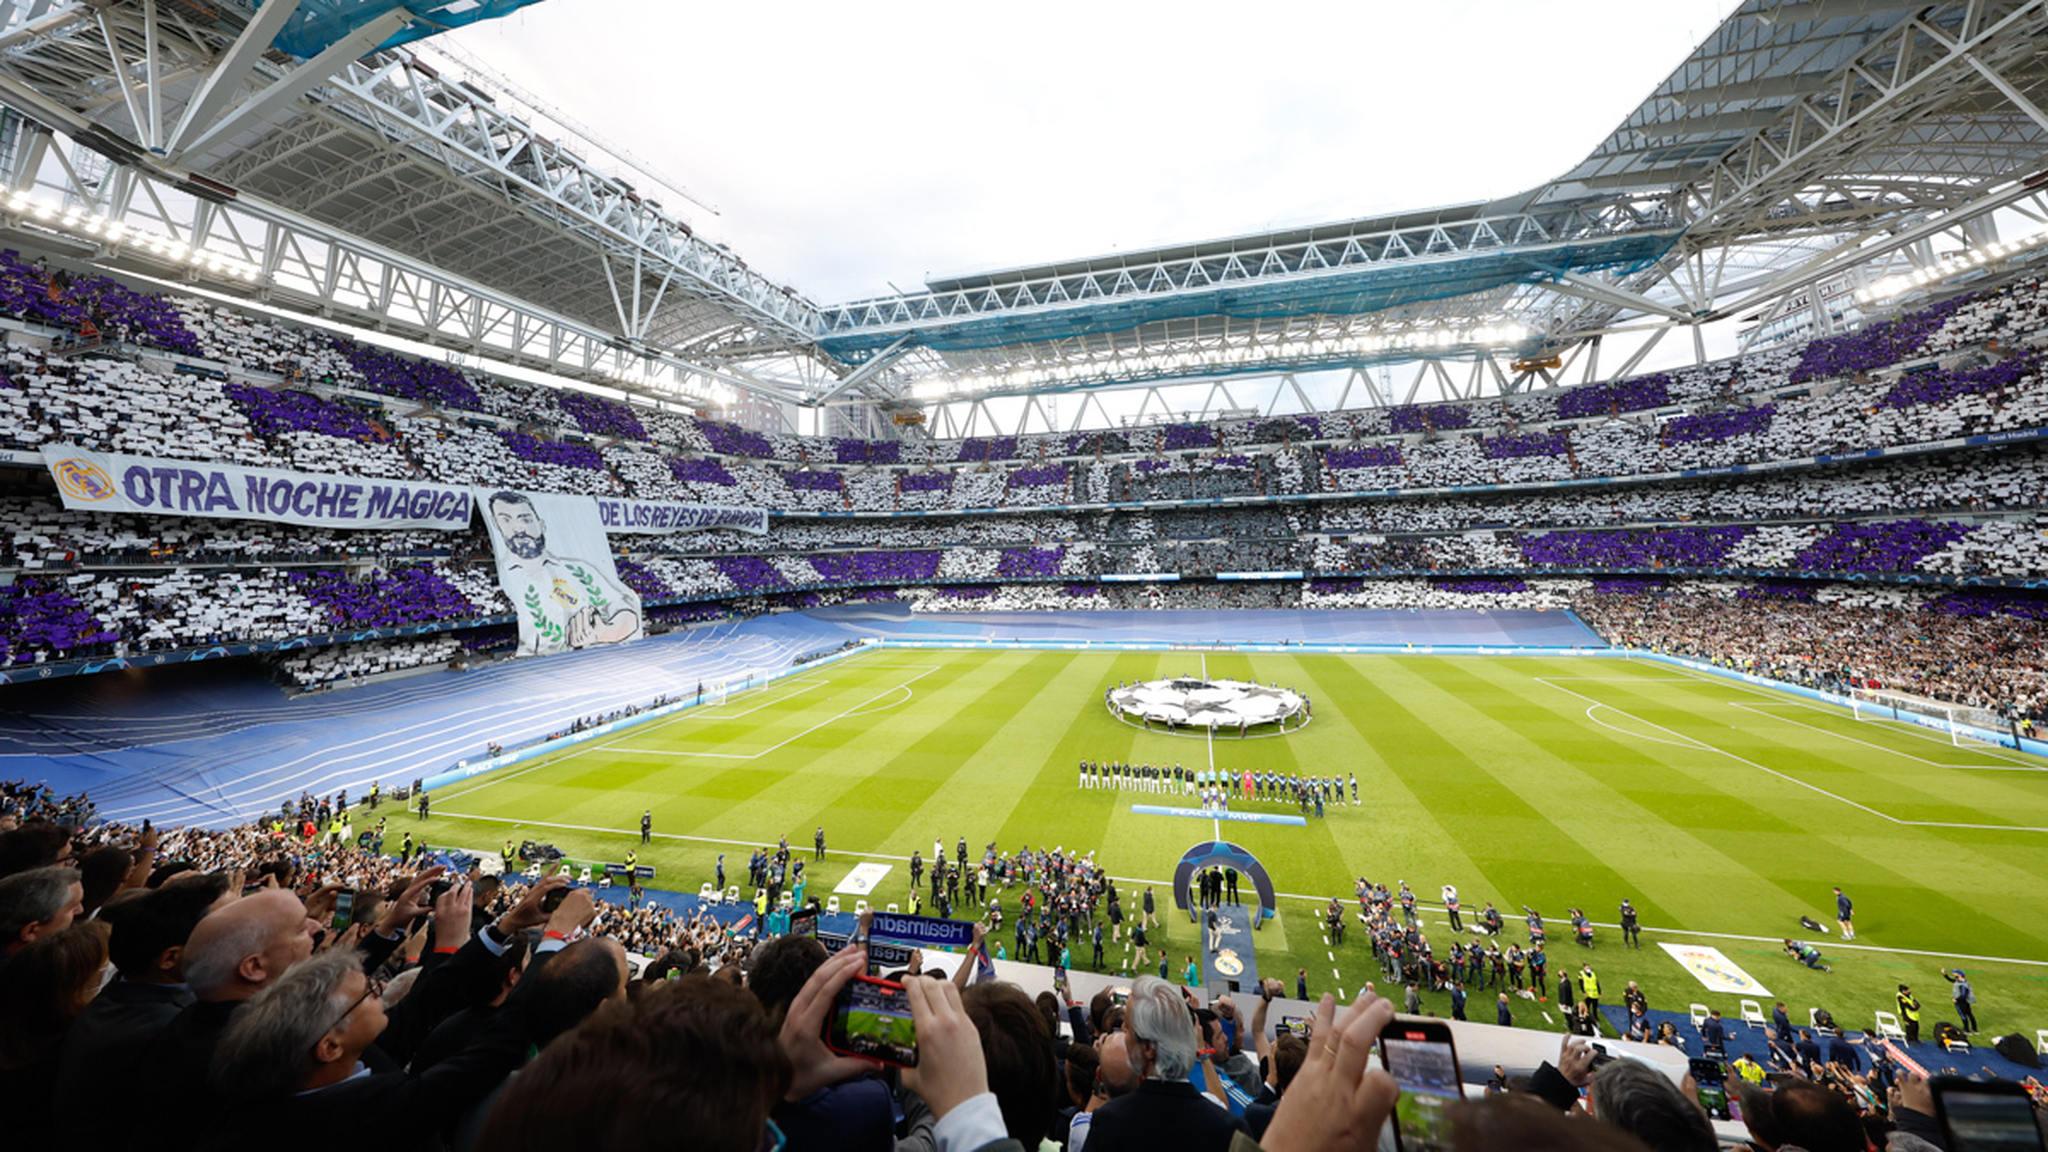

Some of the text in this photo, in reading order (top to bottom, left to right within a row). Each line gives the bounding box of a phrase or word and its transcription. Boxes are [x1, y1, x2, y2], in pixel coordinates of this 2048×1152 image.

[122, 466, 240, 512] OTRA
[244, 475, 363, 518] NOCHE
[599, 502, 764, 530] DE LOS REYES DE EUROPA
